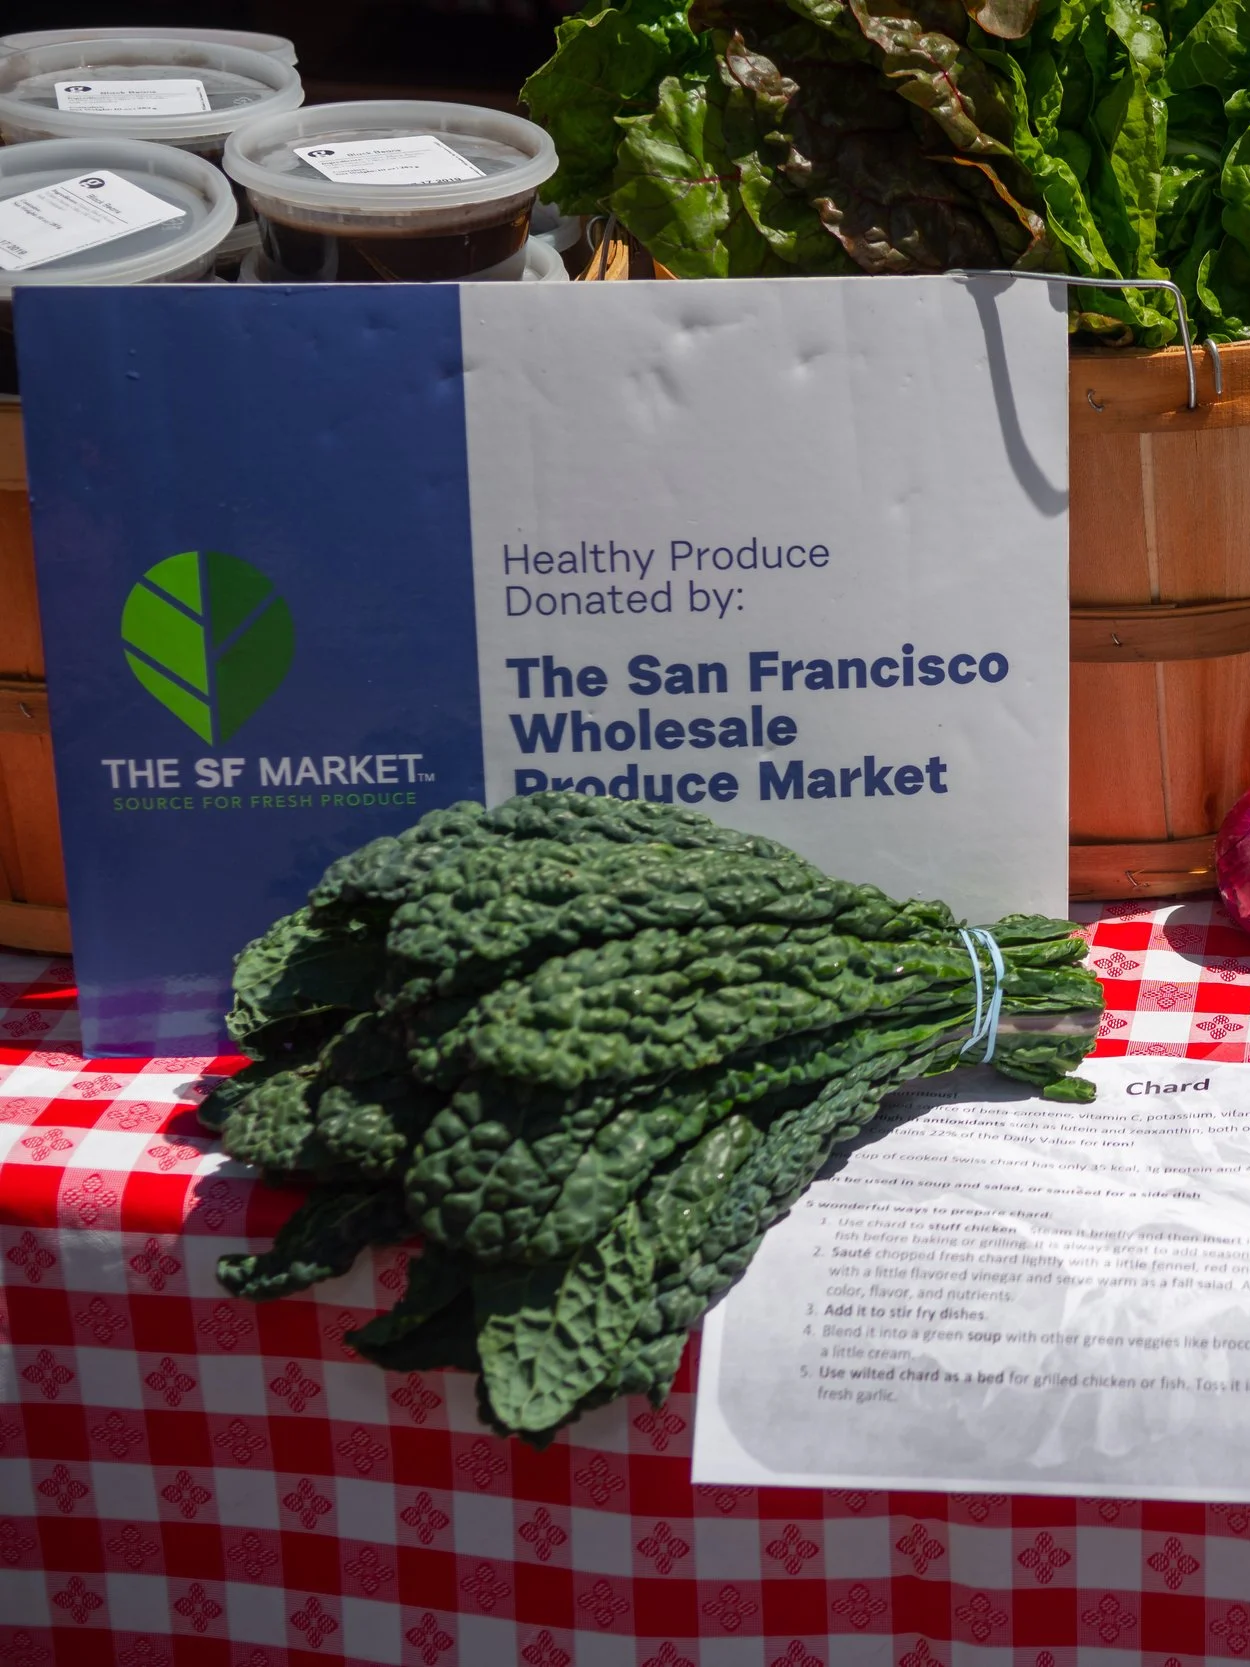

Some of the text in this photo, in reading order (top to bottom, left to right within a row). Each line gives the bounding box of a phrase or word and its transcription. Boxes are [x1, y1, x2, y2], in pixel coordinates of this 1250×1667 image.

[503, 538, 831, 580] Healthy Produce
[505, 581, 744, 618] Donated by:
[505, 643, 1010, 698] The San Francisco
[508, 704, 798, 754] Wholesale
[101, 758, 180, 789] THE
[195, 757, 245, 788] SF
[259, 754, 423, 786] MARKET
[514, 755, 948, 802] Produce Market
[113, 792, 417, 811] SOURCE FOR FRESH PRODUCE
[1126, 1078, 1210, 1095] Chard
[960, 1130, 974, 1139] of
[979, 1132, 999, 1141] the
[1004, 1133, 1036, 1144] Daily
[1040, 1136, 1076, 1145] Value
[1080, 1138, 1098, 1147] for
[864, 1177, 897, 1185] used
[901, 1178, 914, 1186] in
[918, 1181, 951, 1189] soup
[984, 1183, 1023, 1192] salad,
[1106, 1189, 1125, 1197] for
[1172, 1190, 1201, 1199] dish
[806, 1200, 813, 1208] 5
[813, 1203, 890, 1212] wonderful
[893, 1206, 929, 1215] ways
[838, 1218, 1017, 1234] Use chard to stuff chicken
[812, 1247, 824, 1257] 2.
[831, 1247, 872, 1258] Sauté
[875, 1249, 935, 1264] chopped
[939, 1252, 974, 1263] fresh
[978, 1254, 1017, 1265] chard
[1021, 1255, 1064, 1268] lightly
[1069, 1258, 1099, 1268] with
[1104, 1260, 1111, 1268] a
[1151, 1260, 1200, 1274] fennel,
[1204, 1263, 1227, 1273] red
[828, 1265, 860, 1278] with
[863, 1269, 871, 1278] a
[875, 1266, 907, 1279] little
[911, 1268, 967, 1281] flavored
[971, 1271, 1022, 1285] vinegar
[1027, 1273, 1052, 1284] and
[1056, 1274, 1093, 1285] serve
[1098, 1277, 1137, 1287] warm
[1142, 1279, 1156, 1287] as
[1160, 1280, 1168, 1288] a
[1171, 1278, 1194, 1289] fall
[827, 1285, 1014, 1302] color, flavor, and nutrients.
[805, 1303, 987, 1322] 3. Add it to stir fry dishes.
[803, 1325, 815, 1336] 4.
[822, 1325, 862, 1338] Blend
[866, 1326, 875, 1338] it
[880, 1326, 907, 1340] into
[911, 1330, 919, 1340] a
[923, 1330, 963, 1342] green
[968, 1331, 1002, 1344] soup
[1006, 1331, 1037, 1343] with
[1040, 1332, 1079, 1345] other
[1083, 1335, 1124, 1347] green
[1128, 1336, 1180, 1350] veggies
[1184, 1336, 1208, 1348] like
[820, 1346, 915, 1360] a little cream.
[800, 1365, 812, 1378] 5.
[819, 1366, 845, 1378] Use
[850, 1367, 895, 1381] wilted
[899, 1368, 939, 1382] chard
[944, 1372, 959, 1382] as
[964, 1373, 972, 1383] a
[977, 1371, 1004, 1384] bed
[1009, 1371, 1029, 1384] for
[1033, 1373, 1078, 1388] grilled
[1082, 1374, 1136, 1388] chicken
[1140, 1378, 1155, 1389] or
[1160, 1375, 1190, 1390] fish.
[1196, 1378, 1226, 1391] Toss
[1230, 1379, 1240, 1392] it
[818, 1387, 853, 1400] fresh
